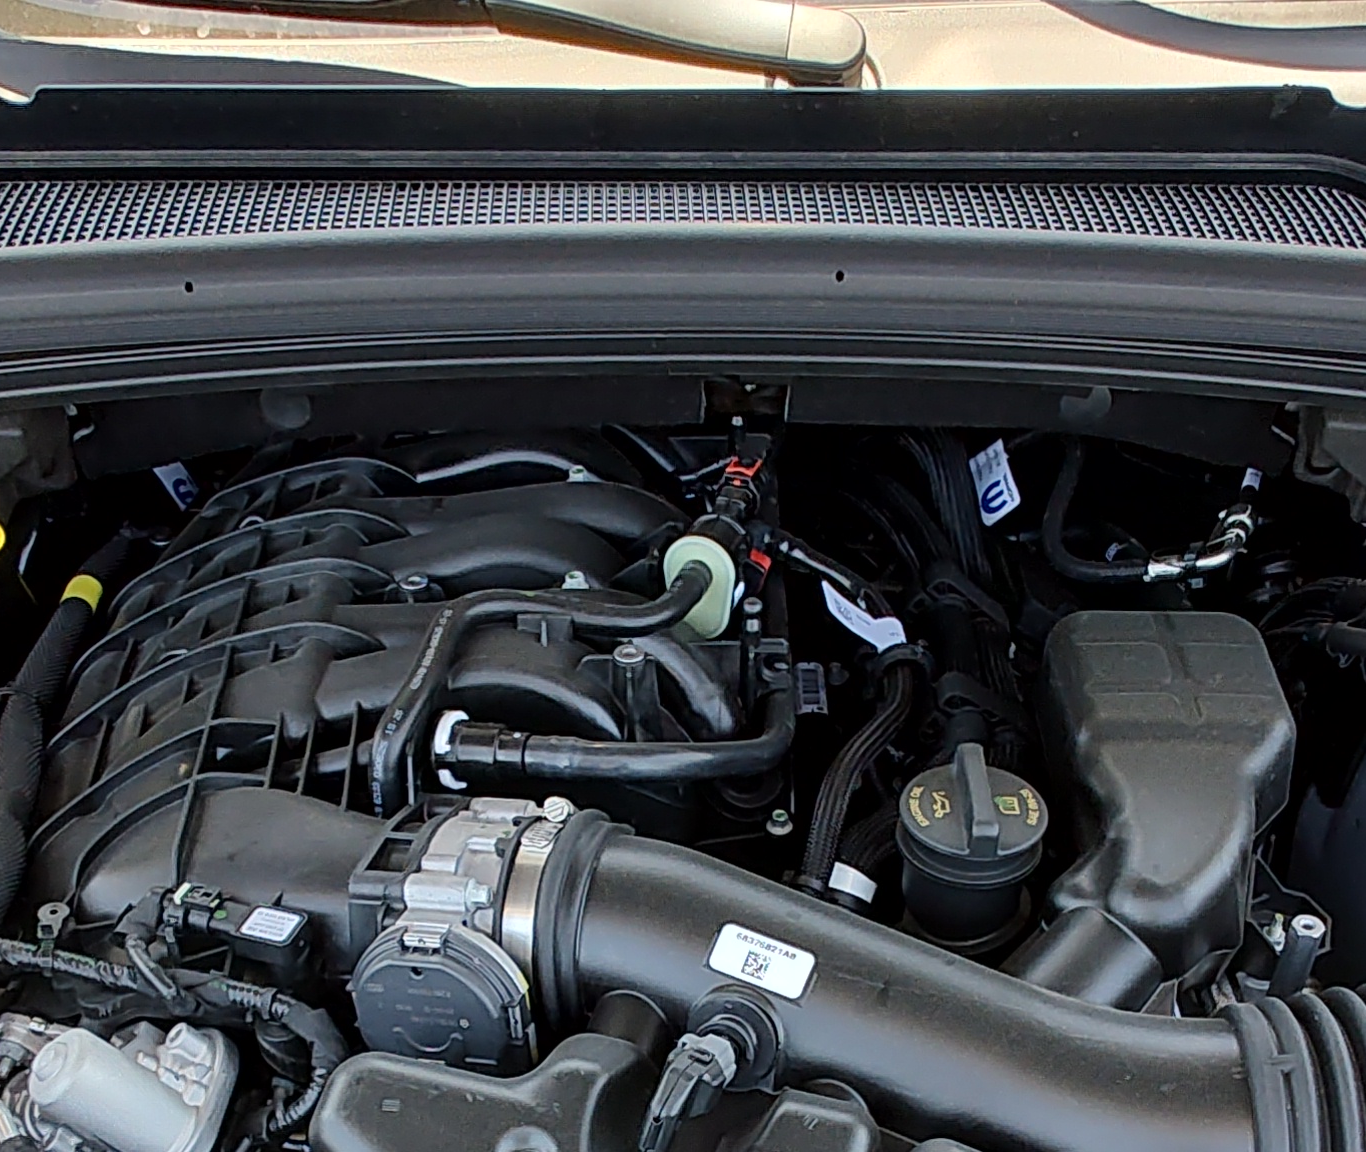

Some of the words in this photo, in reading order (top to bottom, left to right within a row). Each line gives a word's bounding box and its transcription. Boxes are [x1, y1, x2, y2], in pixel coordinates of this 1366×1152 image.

[910, 786, 925, 798] OIL
[909, 798, 930, 827] ENGINE
[736, 932, 797, 960] 68376821AB
